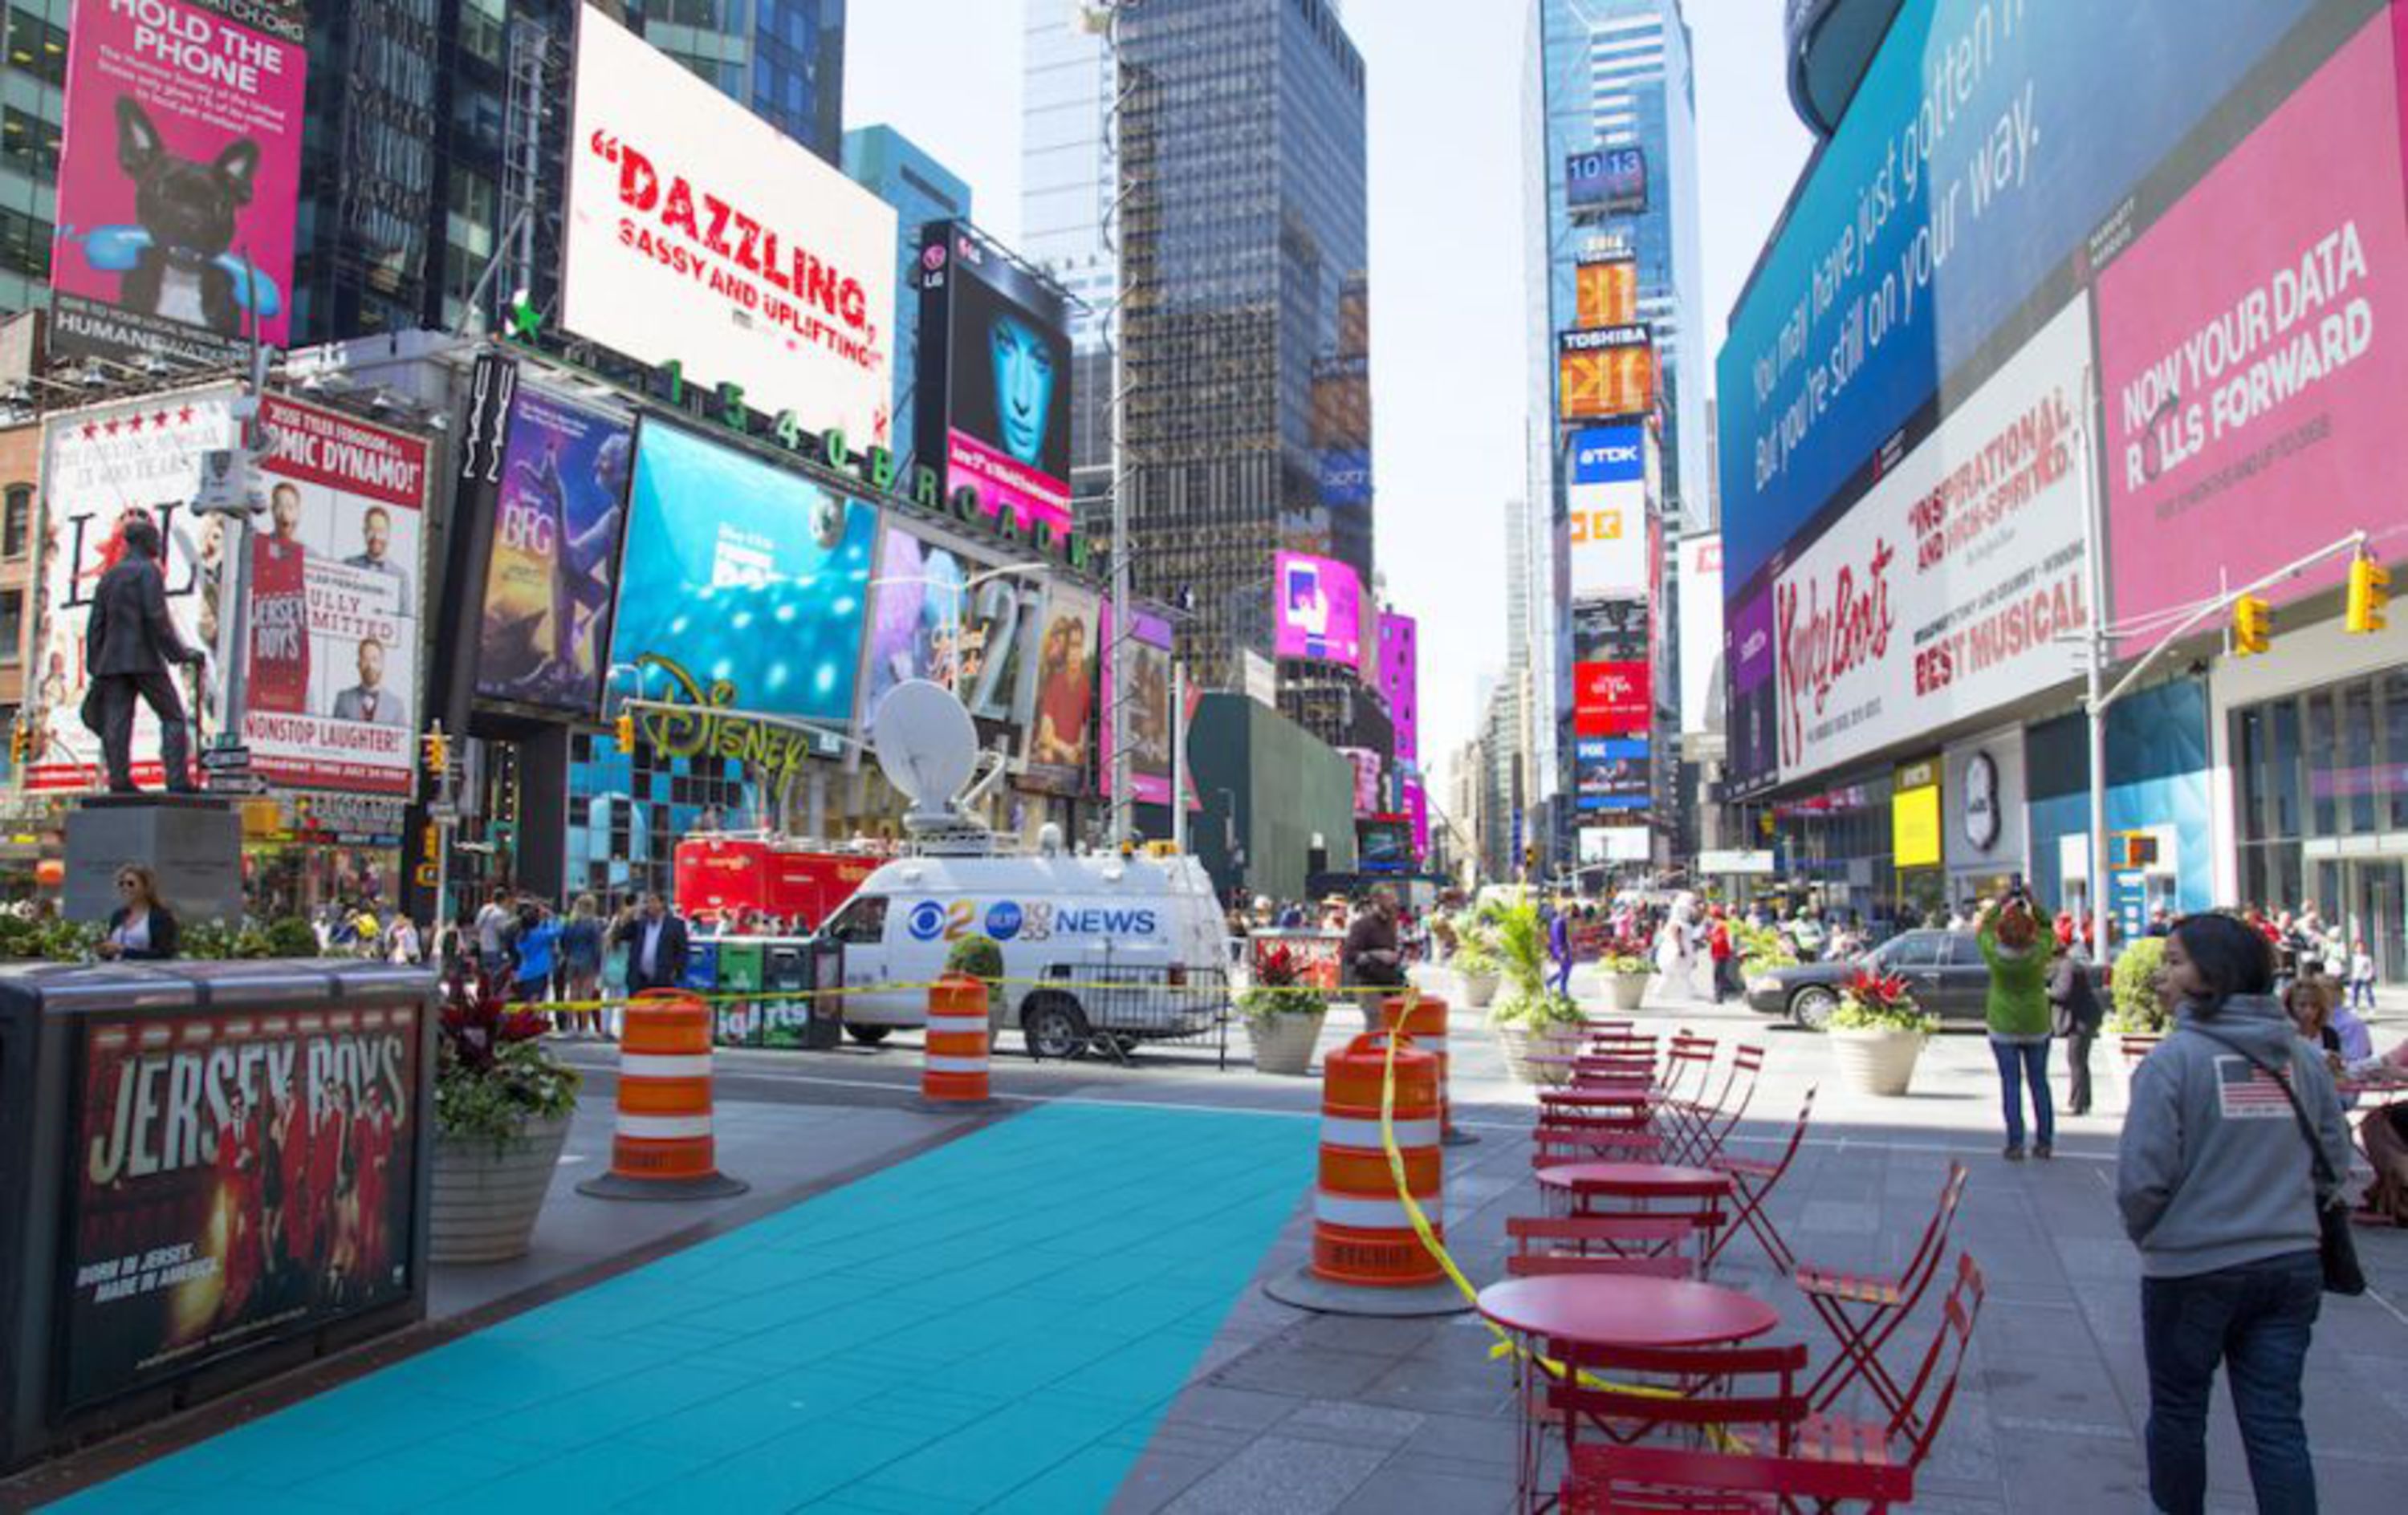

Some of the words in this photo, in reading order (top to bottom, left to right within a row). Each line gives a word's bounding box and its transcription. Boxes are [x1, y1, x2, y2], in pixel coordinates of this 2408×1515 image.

[133, 24, 259, 94] PHONE
[218, 26, 283, 74] THE
[1779, 294, 1808, 377] may
[1812, 223, 1856, 325] have
[1857, 138, 1898, 270] just
[1902, 2, 1995, 201] gotten
[618, 217, 708, 281] SASSY
[710, 268, 758, 309] AND
[924, 272, 944, 287] LG
[1755, 425, 1778, 492] But
[1830, 294, 1864, 396] still
[1867, 267, 1895, 348] on
[1901, 180, 1961, 323] your
[1968, 79, 2041, 219] way.
[1564, 327, 1647, 349] TOSHIBA
[2123, 346, 2182, 434] NOW
[2183, 286, 2271, 389] YOUR
[2272, 219, 2367, 335] DATA
[2211, 296, 2373, 439] FORWARD
[1597, 445, 1638, 463] TDK
[502, 502, 555, 555] BFG
[311, 590, 360, 611] ULLY
[256, 626, 301, 660] BOYS
[311, 611, 394, 641] MITTED
[1916, 630, 1964, 697] BEST
[1970, 571, 2088, 674] MUSICAL
[1778, 578, 1832, 767] Kinky
[245, 718, 315, 744] NONSTOP
[943, 898, 976, 941] 2
[1055, 908, 1156, 936] NEWS
[89, 1042, 296, 1185] JERSEY
[307, 1034, 405, 1137] BOYS
